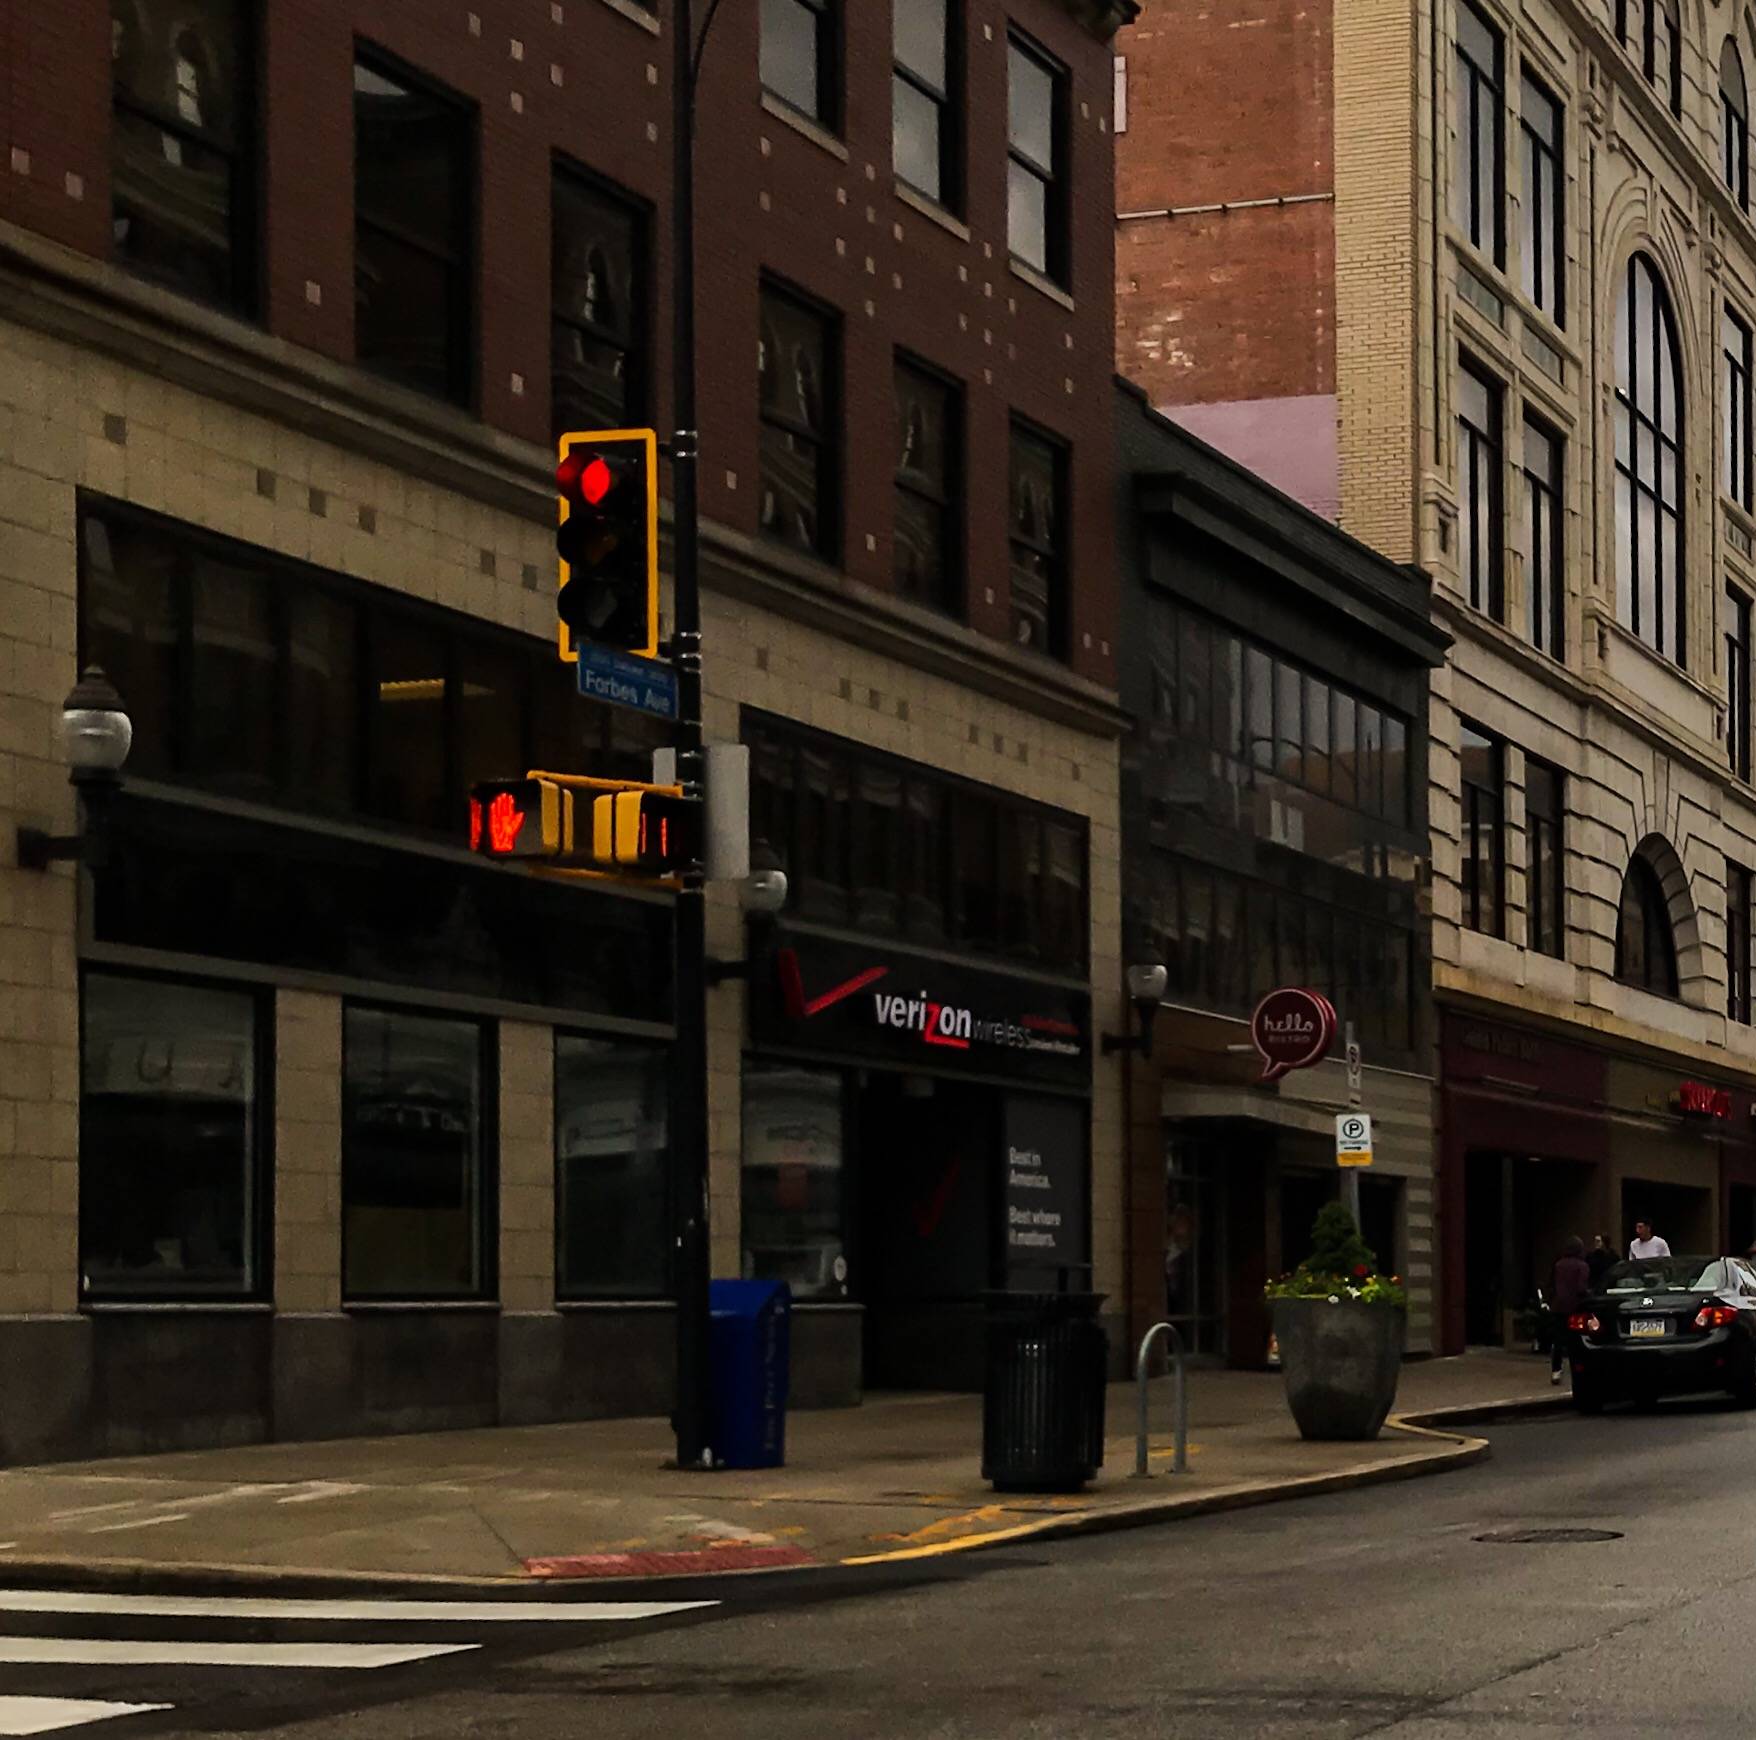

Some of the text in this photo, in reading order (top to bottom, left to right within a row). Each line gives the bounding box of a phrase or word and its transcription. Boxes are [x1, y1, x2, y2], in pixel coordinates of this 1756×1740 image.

[586, 669, 671, 713] Forbes Ave
[875, 990, 971, 1049] verizon
[1263, 1013, 1314, 1033] hello
